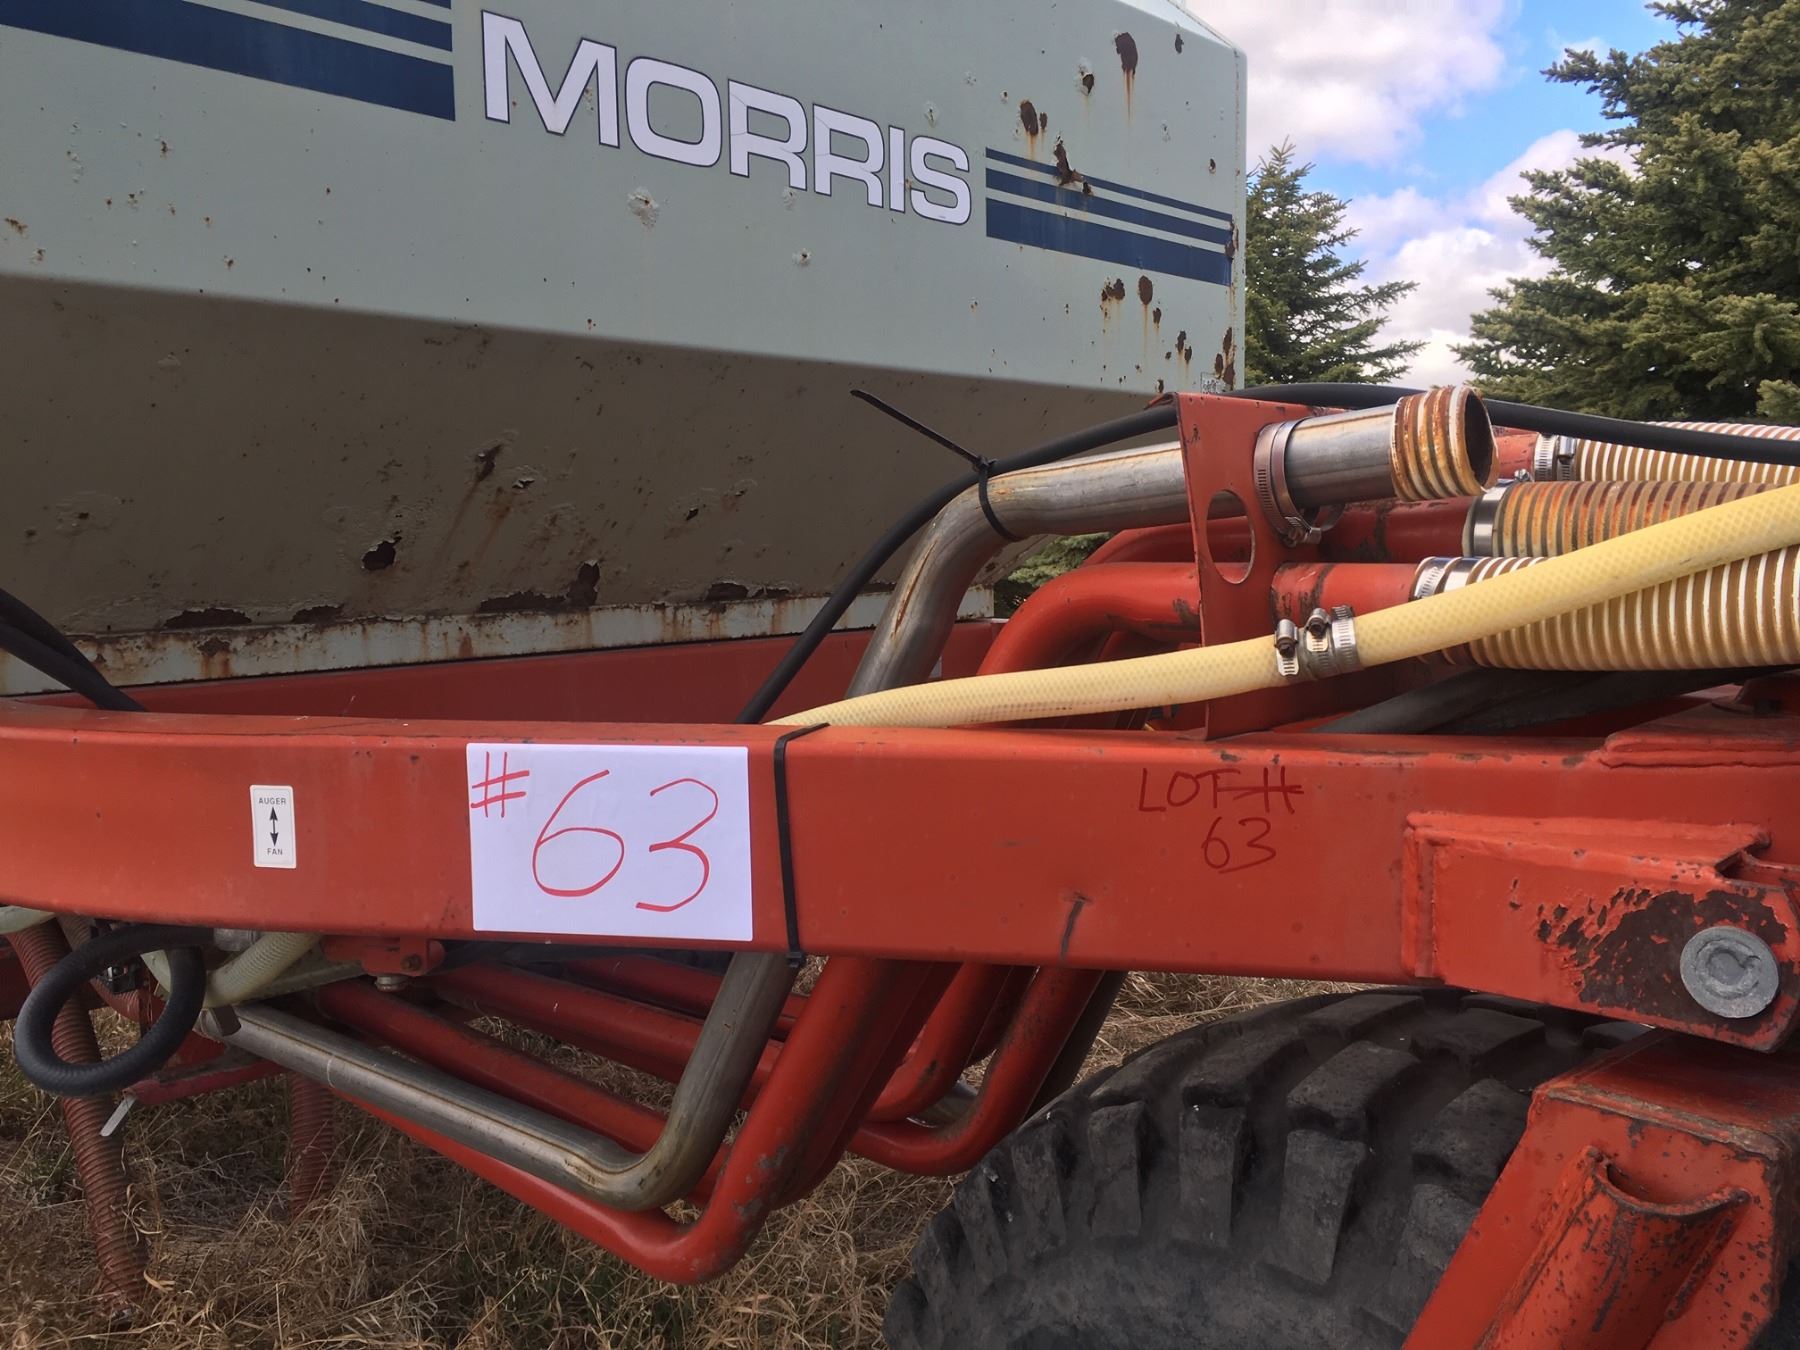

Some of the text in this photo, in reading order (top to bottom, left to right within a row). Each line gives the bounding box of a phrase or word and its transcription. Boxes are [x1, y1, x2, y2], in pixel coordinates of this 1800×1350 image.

[481, 9, 972, 226] MORRIS
[259, 797, 287, 805] AUGER
[267, 847, 283, 856] FAN
[1201, 816, 1277, 875] 63
